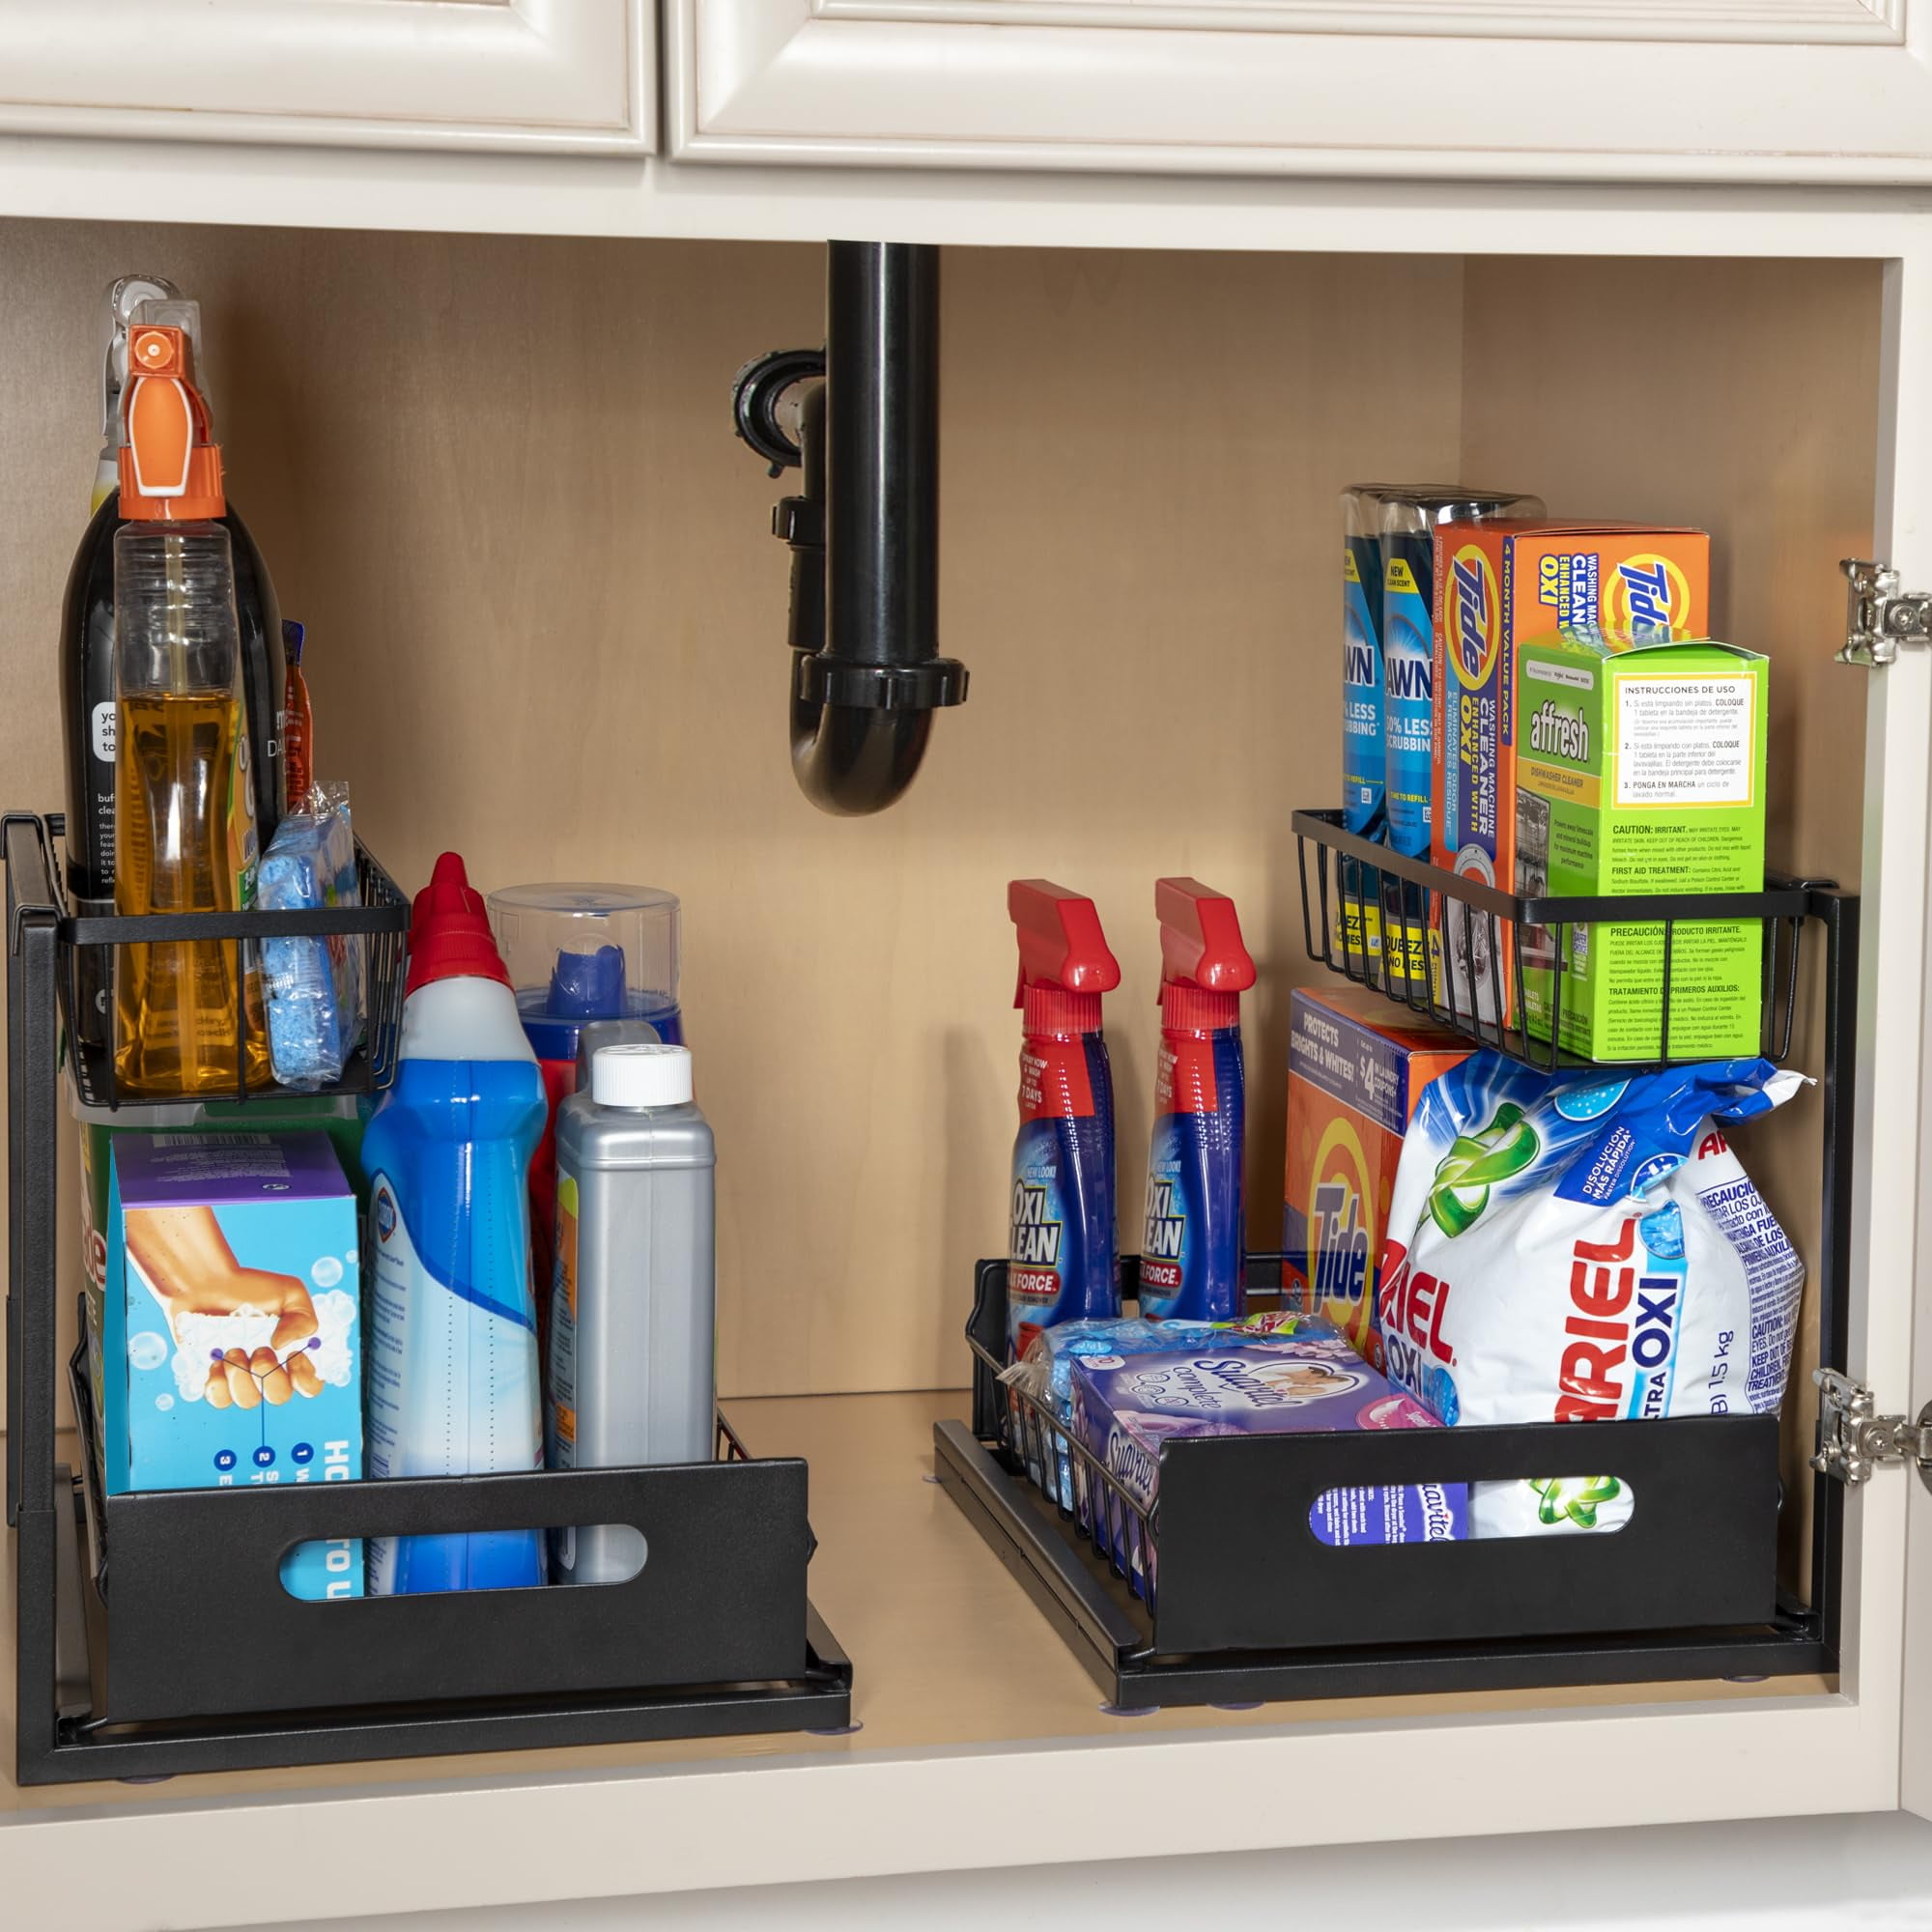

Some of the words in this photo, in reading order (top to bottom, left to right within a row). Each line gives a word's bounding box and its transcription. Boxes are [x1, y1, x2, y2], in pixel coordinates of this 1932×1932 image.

[1504, 544, 1511, 554] 4
[1390, 565, 1404, 577] NEW
[1540, 555, 1558, 605] OXI
[1560, 556, 1570, 617] ENHANCED
[1587, 555, 1597, 603] WASHING
[1503, 560, 1512, 624] MONTH
[1573, 555, 1586, 625] CLEAN
[1453, 555, 1489, 680] Tide
[1345, 645, 1375, 686] WN
[1502, 629, 1511, 685] VALUE
[1386, 657, 1433, 699] AWN
[101, 712, 116, 723] yo
[1350, 703, 1376, 721] LESS
[102, 725, 116, 736] sh
[1387, 737, 1431, 752] SCRUBBIN
[1461, 695, 1472, 766] OXI
[1530, 699, 1589, 761] affresh
[1479, 697, 1489, 836] CLEANER
[1562, 773, 1583, 787] CLEANER
[98, 793, 115, 803] buf
[99, 806, 115, 814] clea
[1304, 1012, 1339, 1047] PROTECTS
[1291, 1030, 1319, 1062] BRIGHTS
[1319, 1046, 1324, 1065] &
[1035, 1058, 1047, 1069] NOW
[1360, 1056, 1375, 1100] $4
[1026, 1087, 1042, 1103] DAYS
[1038, 1166, 1057, 1178] LOOK!
[1582, 1126, 1625, 1194] DISOLUCIÓN
[1013, 1180, 1044, 1226] OXI
[1592, 1175, 1610, 1200] MÁS
[1604, 1179, 1617, 1200] FASTER
[1729, 1198, 1749, 1214] LOS
[1746, 1208, 1763, 1221] con
[1144, 1220, 1182, 1257] EAN
[1756, 1215, 1777, 1232] FUE
[1765, 1228, 1783, 1244] LOS
[1012, 1226, 1059, 1263] LEAN
[1312, 1182, 1369, 1315] Tide
[1017, 1275, 1053, 1292] FORCE
[1147, 1266, 1176, 1285] FORCE
[1632, 1278, 1678, 1369] OXI
[1752, 1318, 1783, 1339] CAUTION:
[1714, 1330, 1734, 1358] kg
[1752, 1335, 1768, 1352] EYES.
[1752, 1352, 1769, 1366] KEEP
[1770, 1348, 1779, 1360] OUT
[1387, 1334, 1423, 1399] OXI
[1708, 1363, 1728, 1389] 1.5
[1173, 1366, 1223, 1409] complete
[1194, 1359, 1303, 1409] Suavitel
[1644, 1372, 1666, 1420] TRA
[220, 1456, 230, 1465] 3
[259, 1452, 270, 1462] 2
[325, 1439, 350, 1481] HO
[1421, 1484, 1450, 1543] uavitel
